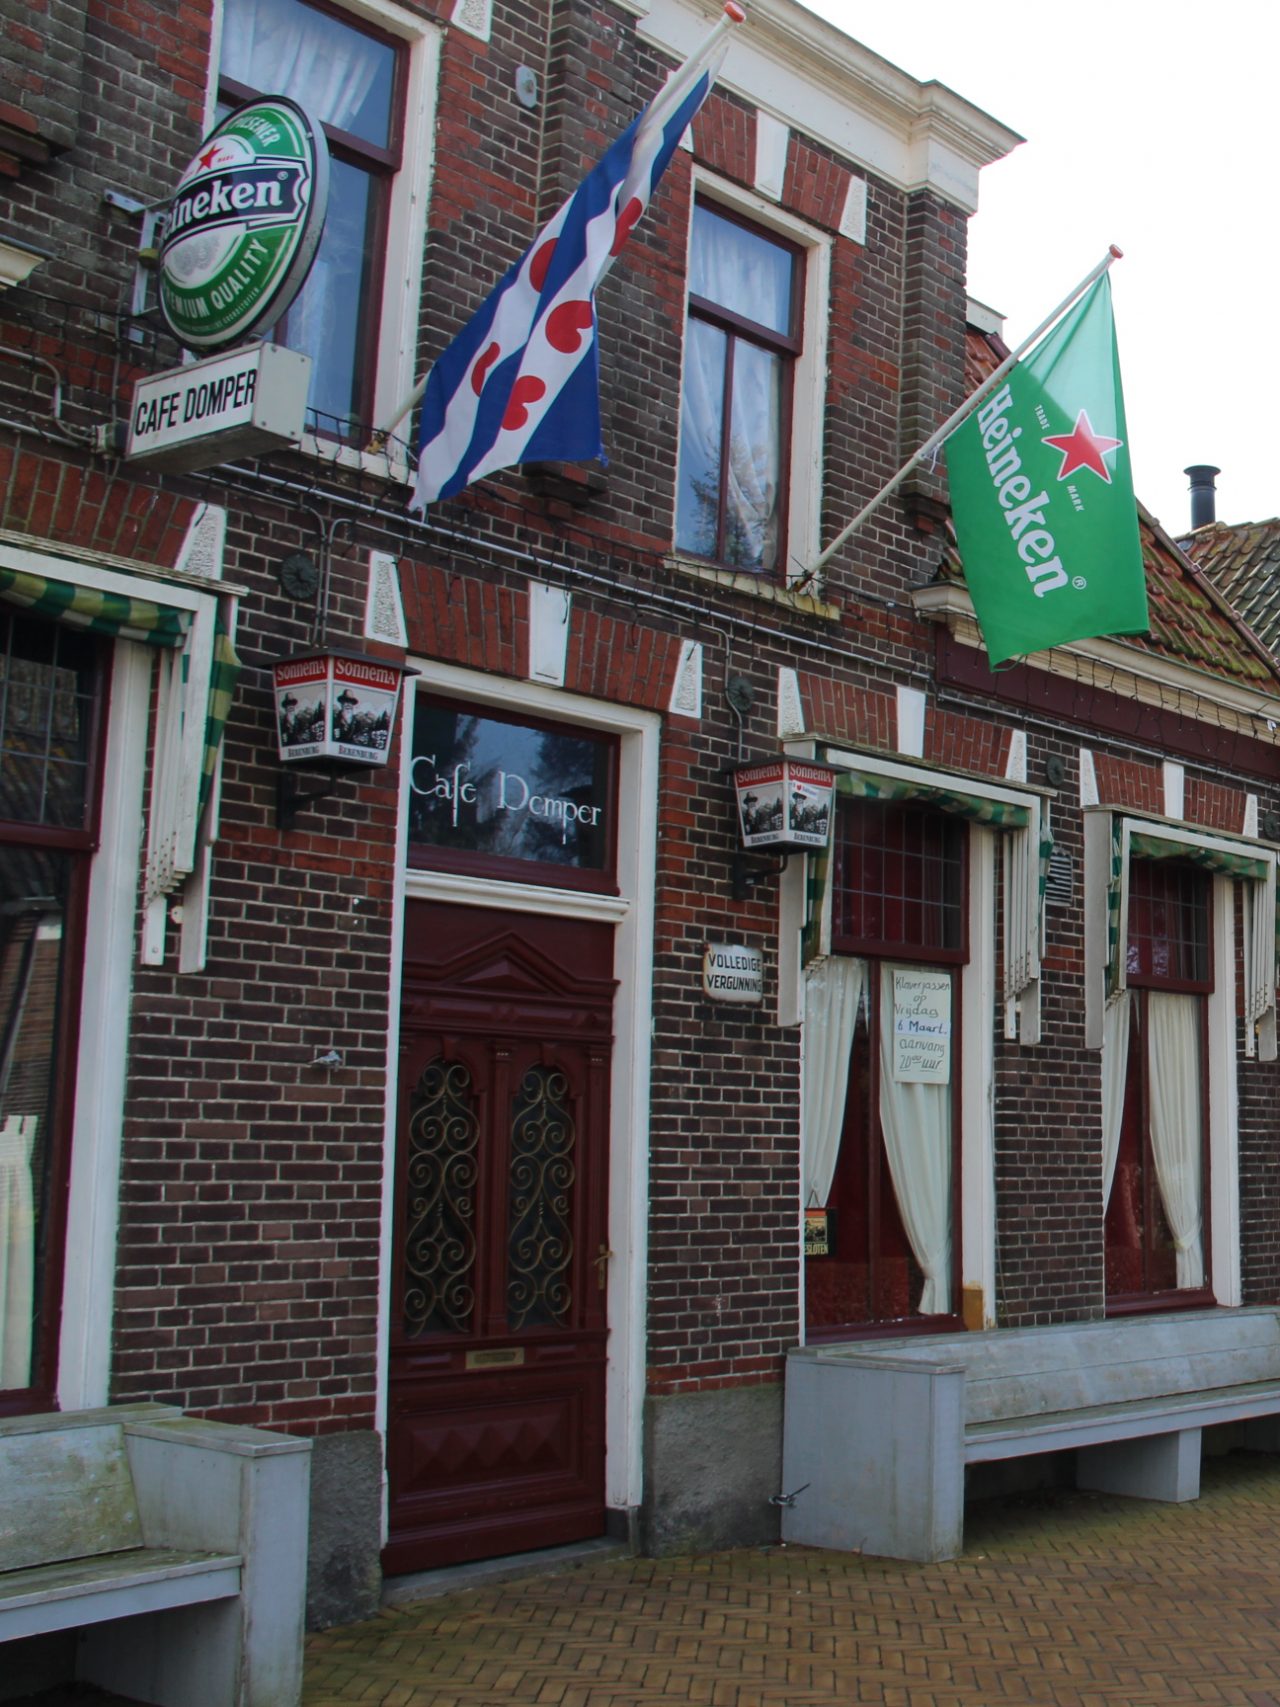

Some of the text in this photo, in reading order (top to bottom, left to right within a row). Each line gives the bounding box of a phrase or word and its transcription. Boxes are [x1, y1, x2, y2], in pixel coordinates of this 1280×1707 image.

[210, 238, 268, 310] QUALITY
[135, 368, 257, 436] CAFE DOMPER
[1034, 404, 1050, 431] TRADE
[977, 383, 1069, 599] Heineken
[1066, 485, 1085, 512] MARK
[410, 754, 602, 845] Cafe Domper
[708, 953, 762, 972] VOLLEDIGE
[706, 974, 762, 993] VERGUNNING
[913, 995, 928, 1007] op
[897, 1020, 904, 1031] 6
